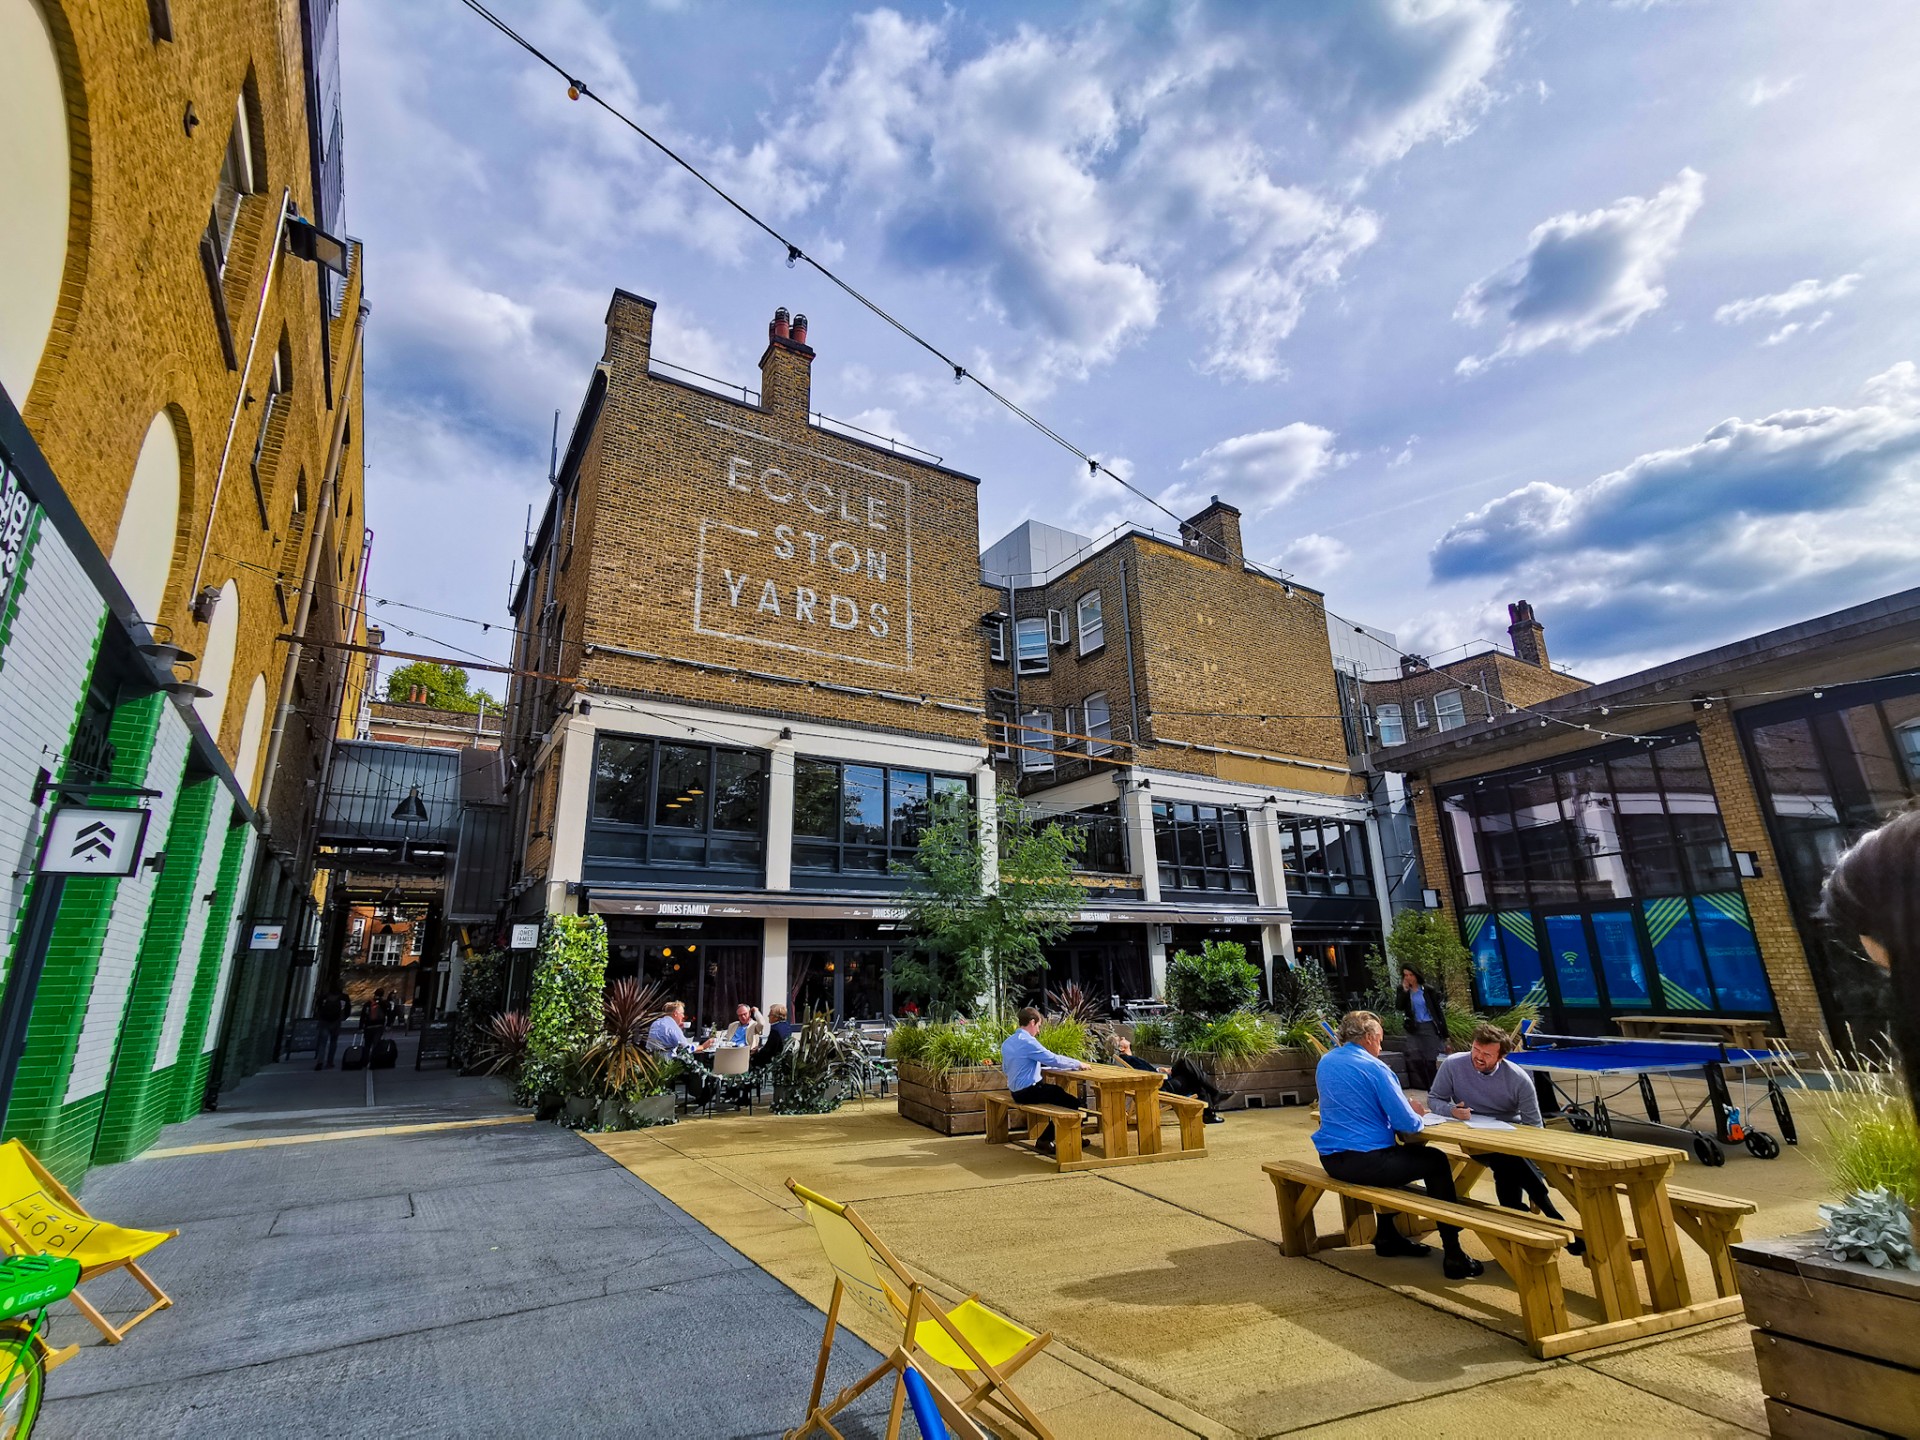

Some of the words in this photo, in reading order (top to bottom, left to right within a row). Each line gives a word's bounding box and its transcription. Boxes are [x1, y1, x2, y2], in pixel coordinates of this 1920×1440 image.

[728, 456, 888, 532] ECCLE
[774, 524, 888, 583] STON
[723, 569, 890, 638] YARDS
[658, 903, 682, 914] JONES
[683, 904, 710, 915] FAMILY
[872, 908, 890, 919] JONES
